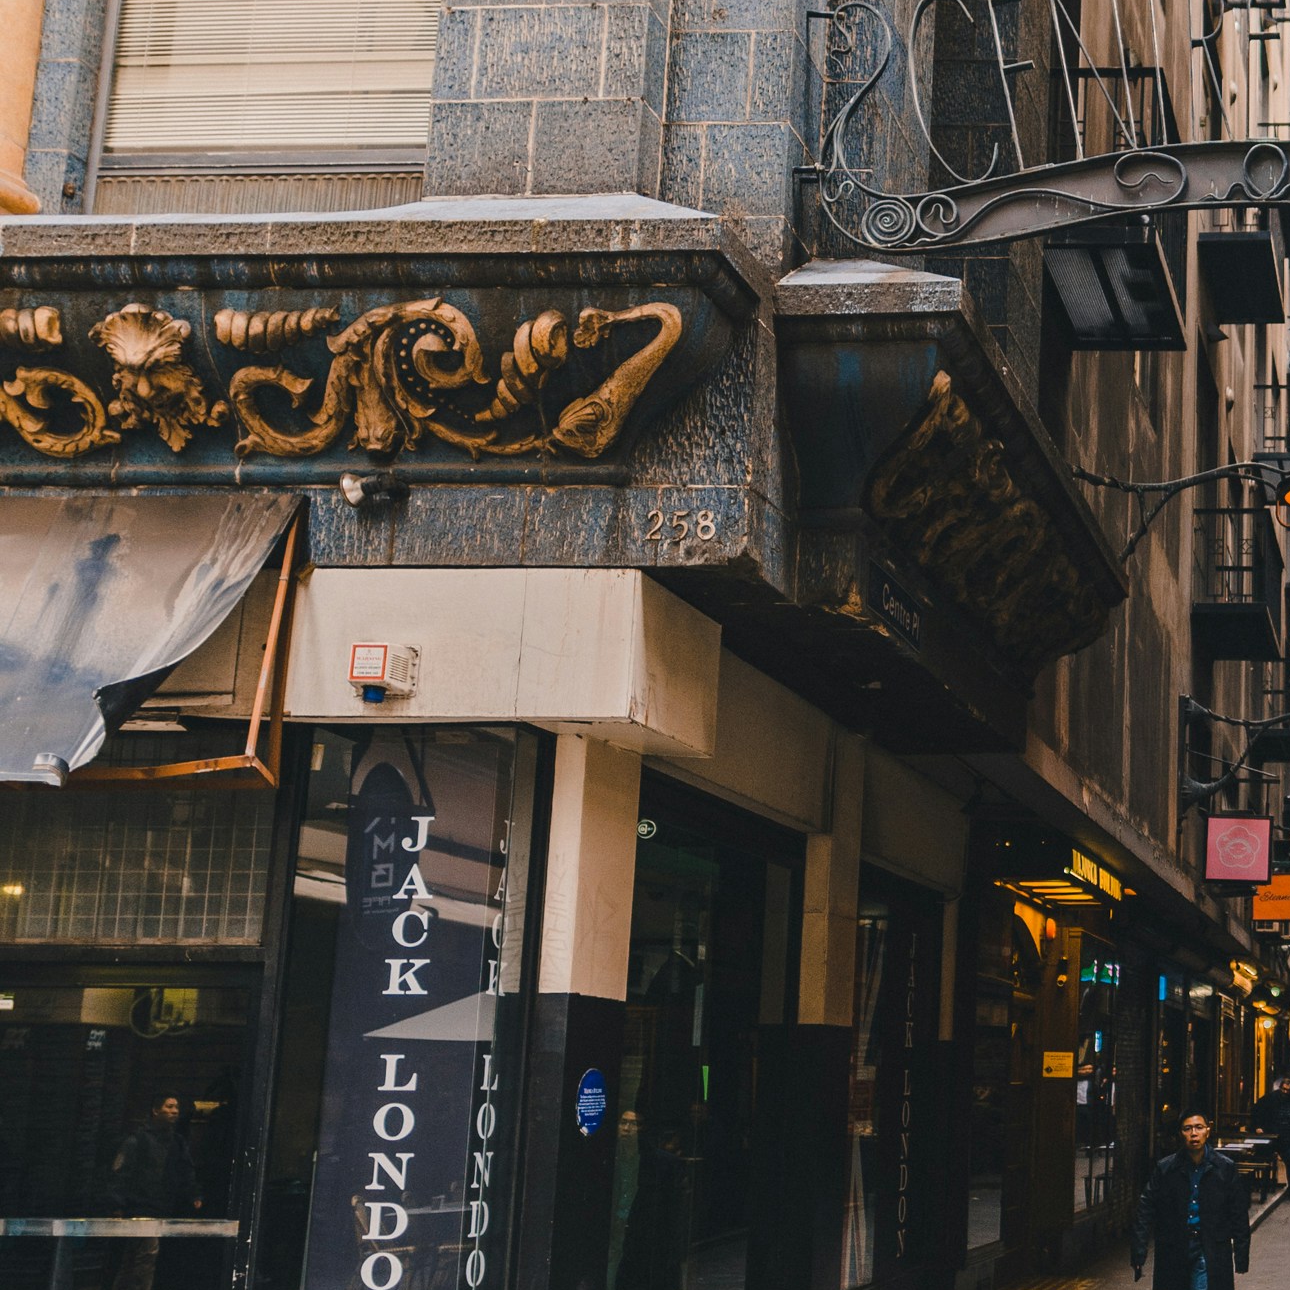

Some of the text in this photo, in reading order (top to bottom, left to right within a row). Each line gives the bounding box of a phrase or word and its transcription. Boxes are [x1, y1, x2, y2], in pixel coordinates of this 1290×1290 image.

[643, 509, 716, 541] 258
[382, 816, 436, 995] JACK
[486, 820, 515, 996] JACK
[896, 1069, 911, 1260] LONDON
